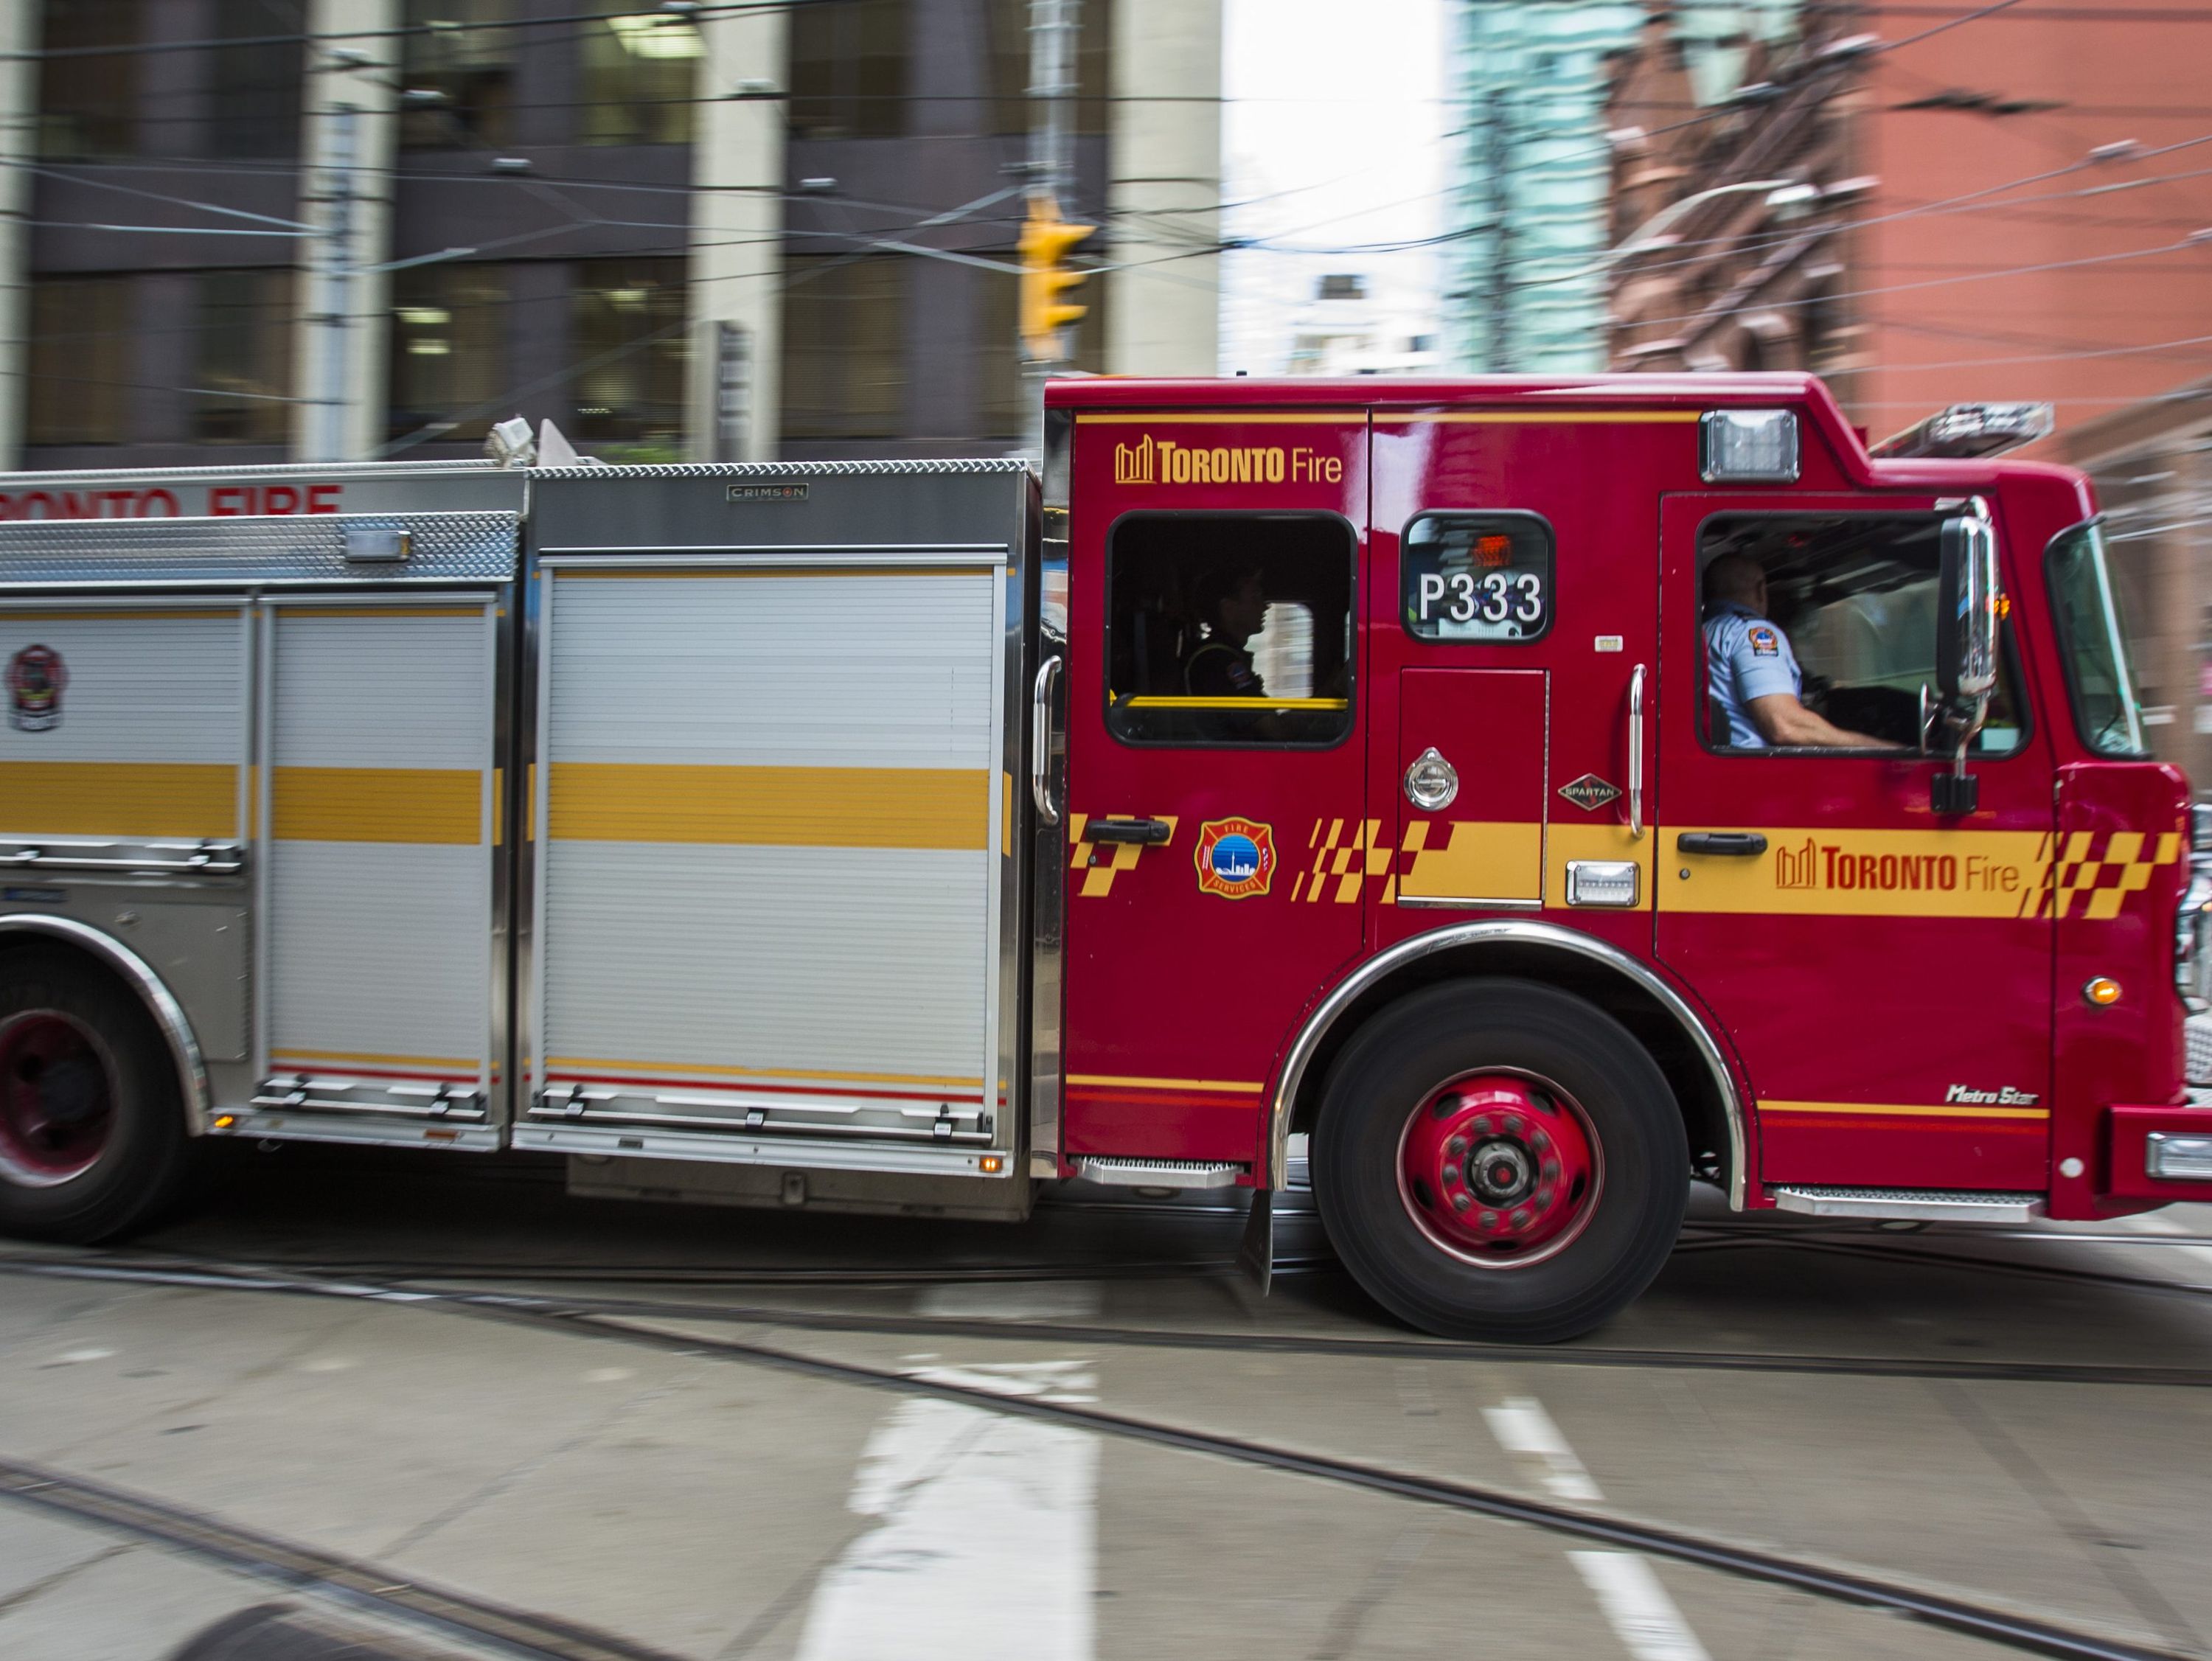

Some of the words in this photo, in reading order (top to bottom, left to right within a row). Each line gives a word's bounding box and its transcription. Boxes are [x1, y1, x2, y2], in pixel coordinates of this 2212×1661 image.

[1157, 441, 1285, 484] TORONTO
[1292, 447, 1343, 483] Fire
[731, 487, 804, 498] CRIMSON
[1420, 572, 1543, 622] P333
[1565, 787, 1615, 797] SPARTAN
[1224, 823, 1250, 834] FIRE
[1820, 846, 1958, 891] TORONTO
[1965, 854, 2020, 893] Fire
[1213, 879, 1256, 894] SERVICES
[1945, 1084, 1999, 1104] Metro
[1997, 1085, 2039, 1105] Star
